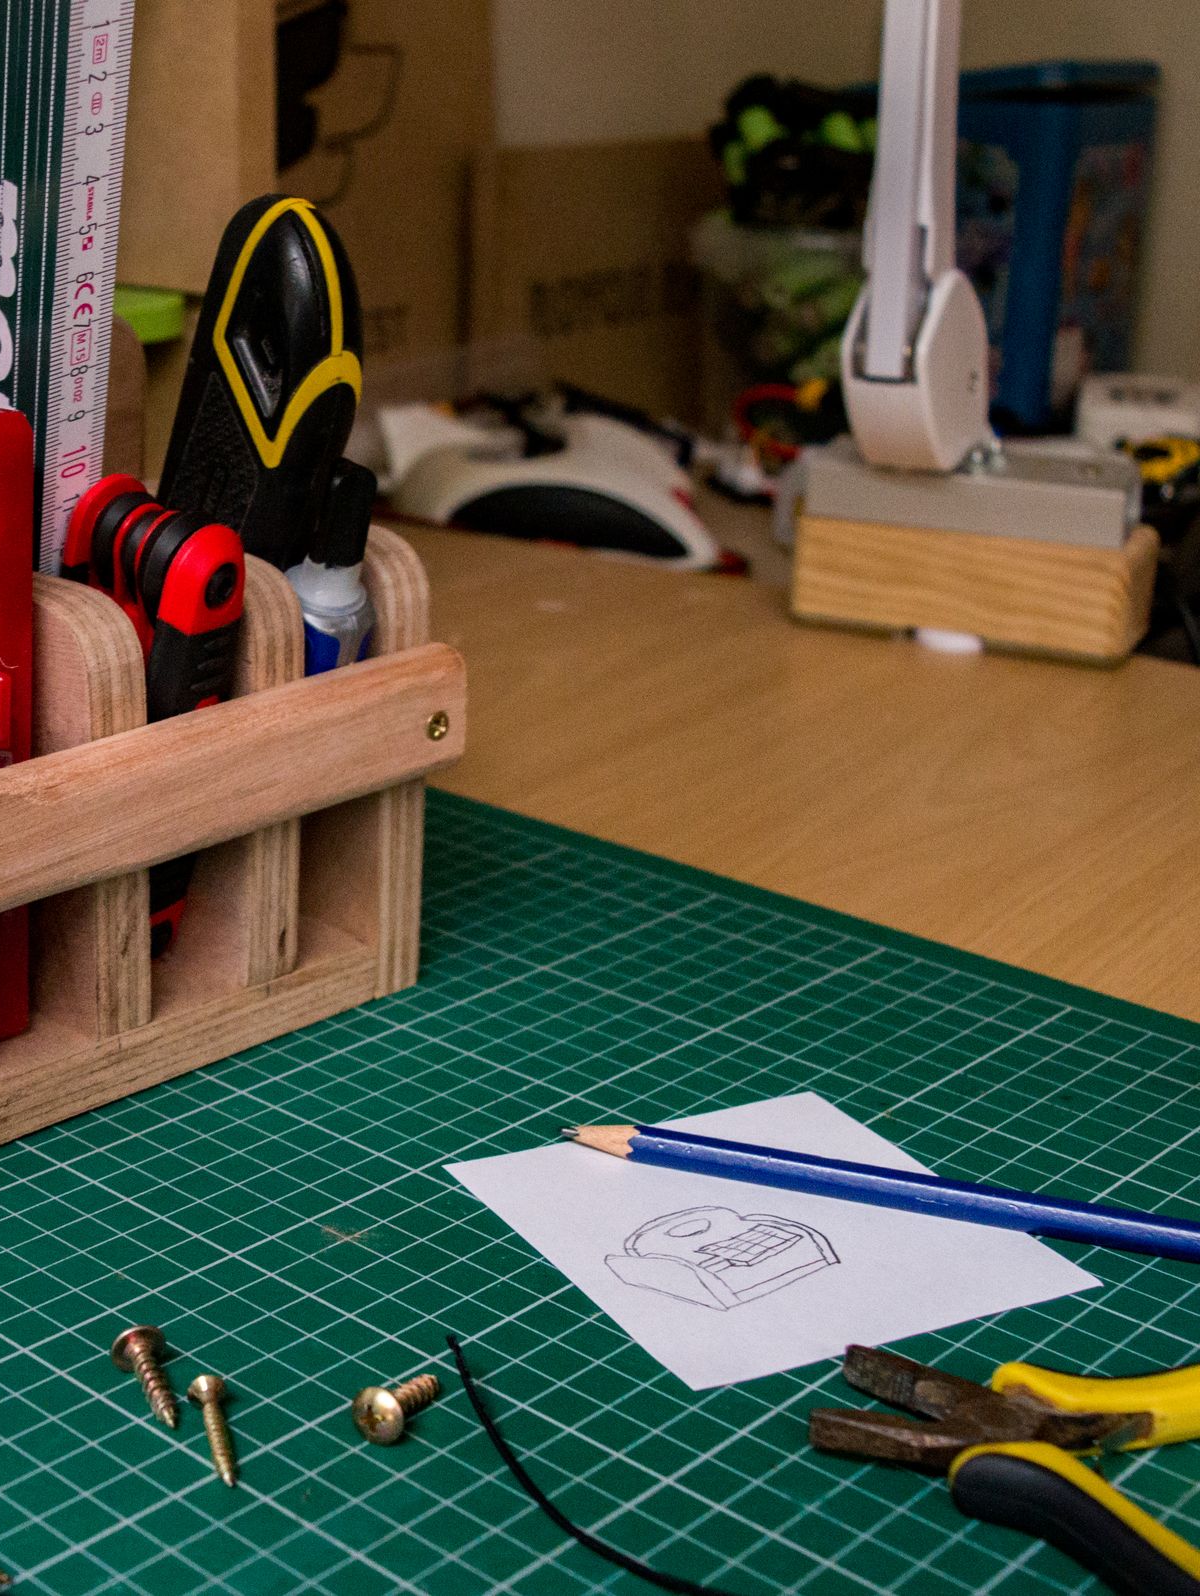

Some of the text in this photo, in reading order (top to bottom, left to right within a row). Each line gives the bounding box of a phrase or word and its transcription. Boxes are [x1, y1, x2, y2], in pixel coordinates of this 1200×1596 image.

[91, 20, 110, 29] 1
[88, 71, 107, 84] 2
[85, 123, 104, 136] 3
[82, 175, 100, 186] 4
[86, 186, 95, 221] STABILA
[79, 222, 97, 235] 5
[76, 271, 94, 284] 6
[73, 319, 91, 327] 7
[70, 365, 88, 377] 8
[73, 377, 84, 403] 0102
[67, 410, 86, 422] 9
[61, 445, 86, 478] 10
